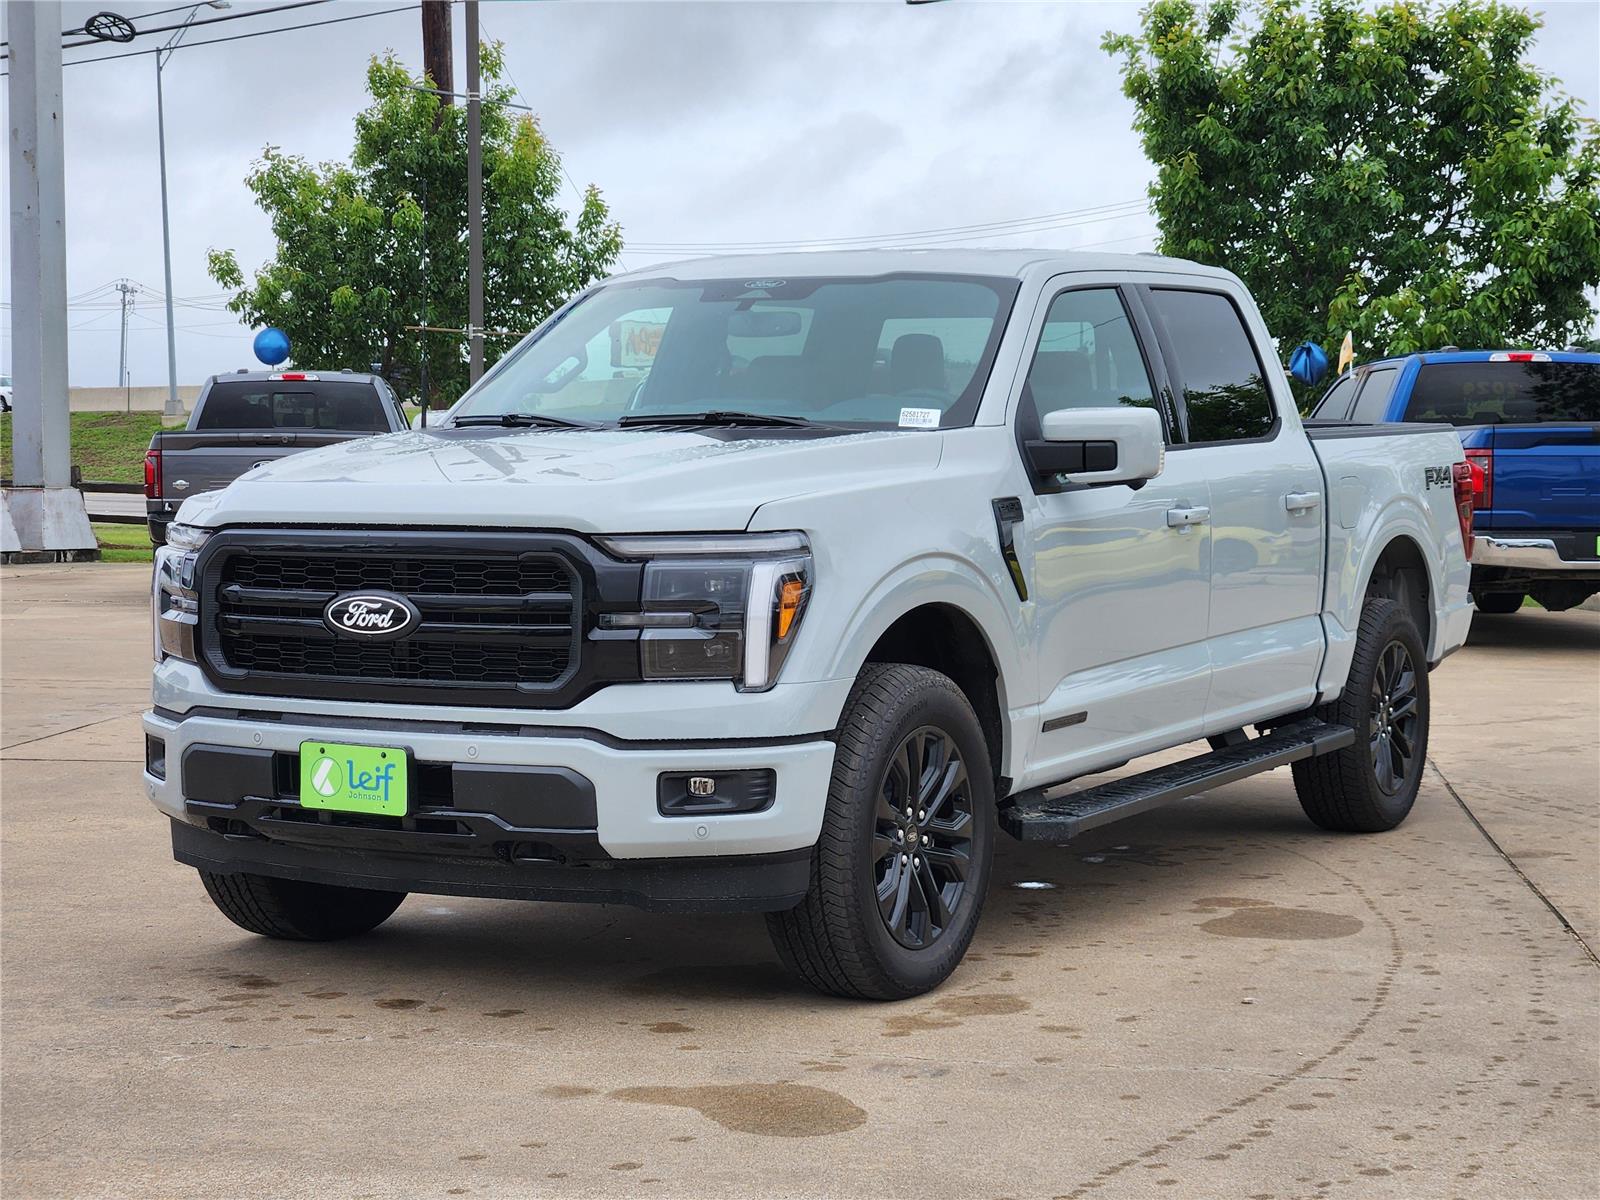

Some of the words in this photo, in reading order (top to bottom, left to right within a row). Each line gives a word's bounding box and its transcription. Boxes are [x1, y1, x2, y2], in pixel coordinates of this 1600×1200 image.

[1424, 466, 1452, 490] FX4
[343, 601, 394, 628] Ford
[346, 760, 396, 801] leif
[348, 791, 382, 801] Johnson
